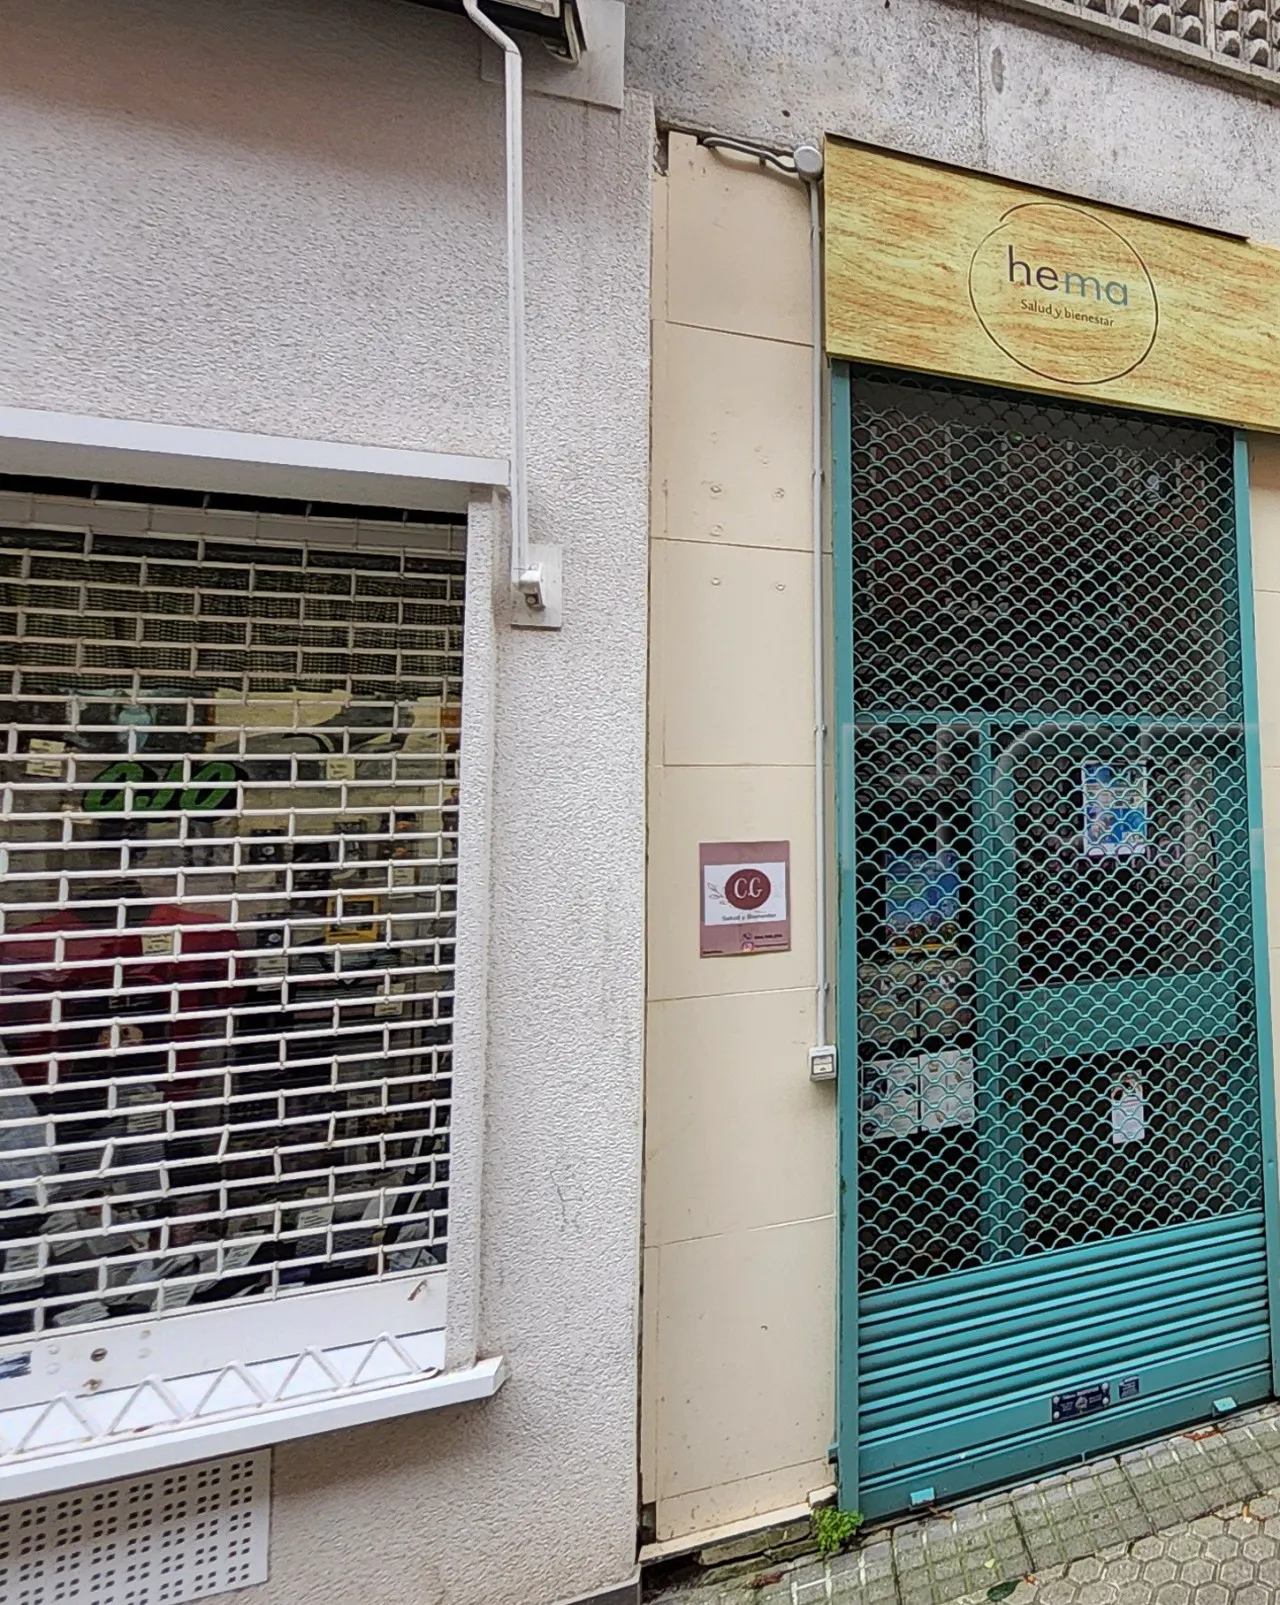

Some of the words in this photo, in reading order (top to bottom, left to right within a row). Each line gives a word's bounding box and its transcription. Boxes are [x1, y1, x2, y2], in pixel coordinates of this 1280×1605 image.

[1007, 244, 1129, 307] hema
[1020, 298, 1053, 315] Salud
[1053, 308, 1062, 320] y
[1064, 307, 1115, 328] bienestar
